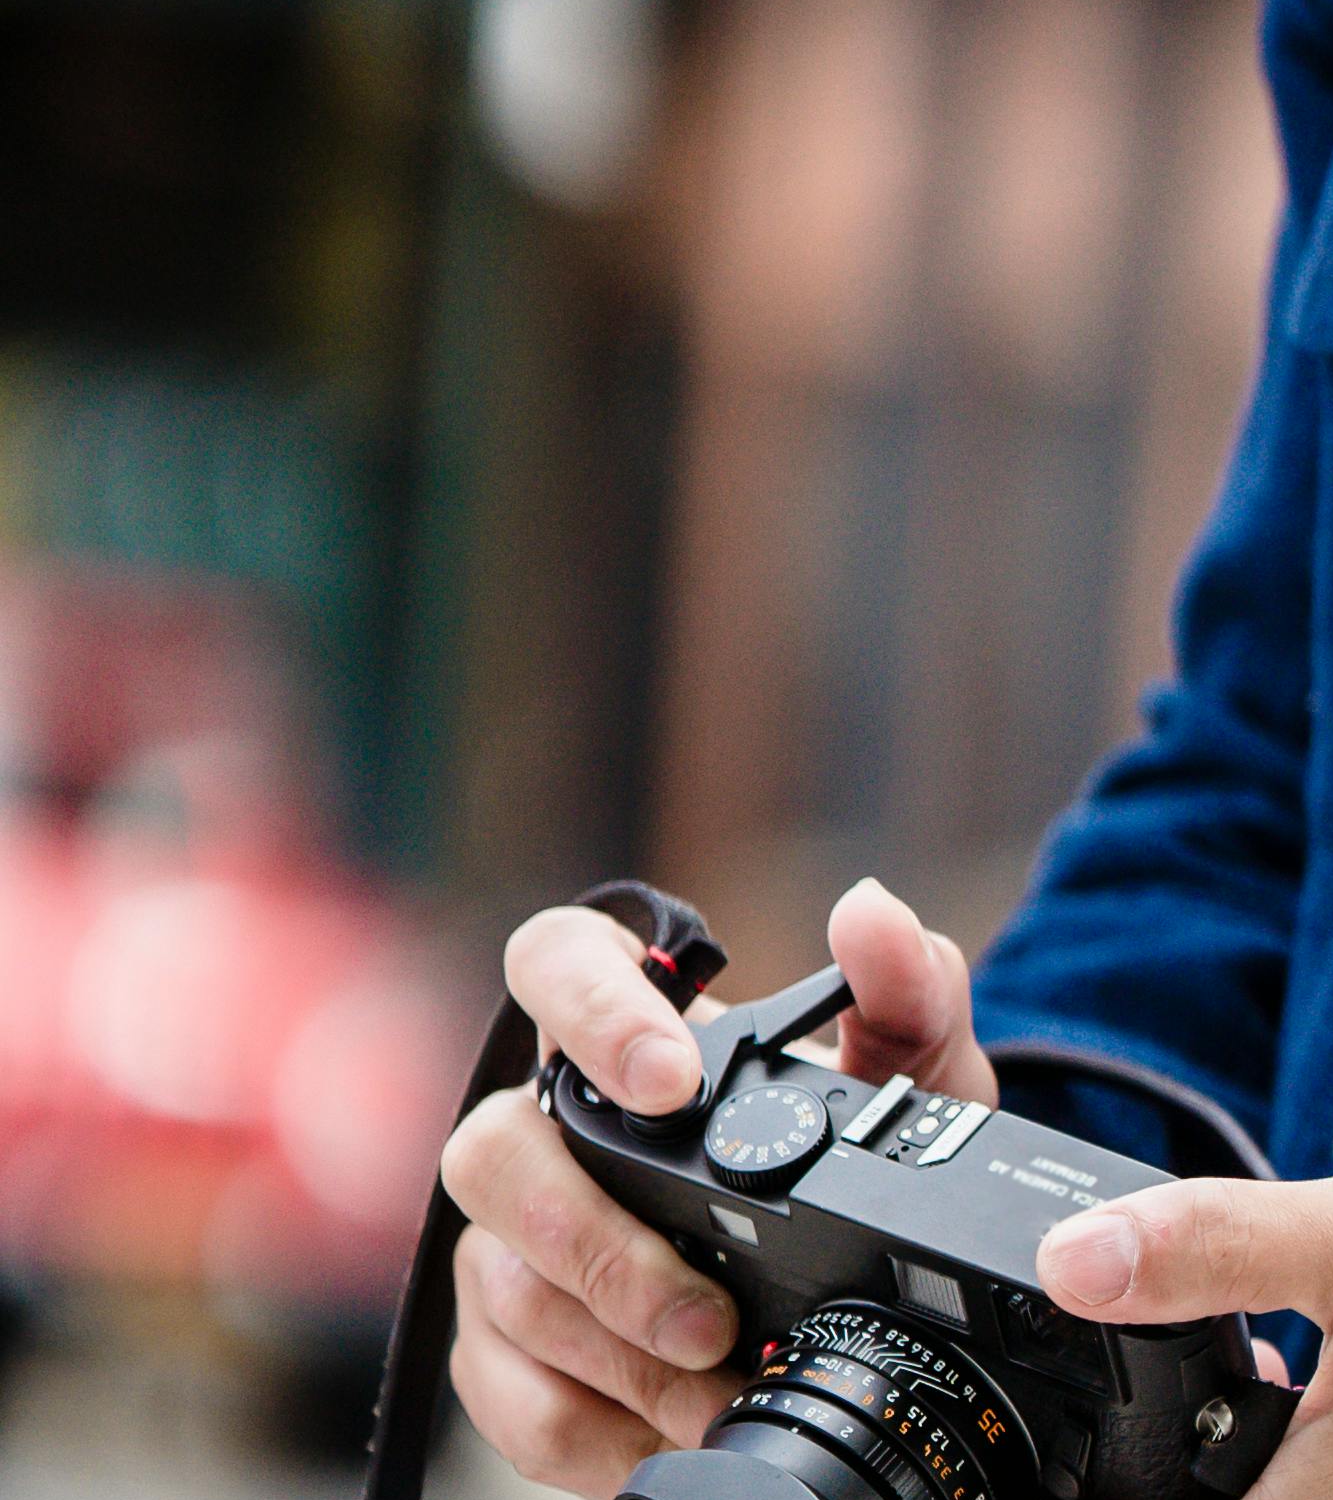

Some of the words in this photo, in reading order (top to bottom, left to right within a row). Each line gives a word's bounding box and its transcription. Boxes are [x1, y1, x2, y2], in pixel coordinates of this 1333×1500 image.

[988, 1159, 1011, 1175] AG
[1030, 1156, 1098, 1188] GERMANY
[1012, 1167, 1069, 1197] CAMERA
[867, 1321, 881, 1333] 2
[885, 1329, 910, 1347] 2.8
[911, 1342, 934, 1363] 5.6
[843, 1365, 856, 1377] 5
[933, 1360, 946, 1372] 8
[862, 1374, 875, 1387] 3
[945, 1369, 959, 1385] 11
[862, 1394, 875, 1406] 8
[886, 1389, 900, 1403] 2
[963, 1384, 977, 1403] 16
[804, 1406, 830, 1423] 2.8
[883, 1408, 895, 1419] 6
[907, 1405, 927, 1428] 1.5
[839, 1426, 854, 1439] 2
[899, 1421, 912, 1435] 5
[977, 1408, 1006, 1444] 35
[930, 1428, 950, 1452] 1.2
[932, 1455, 952, 1480] 3.5
[955, 1459, 965, 1472] 1
[953, 1487, 965, 1500] 3
